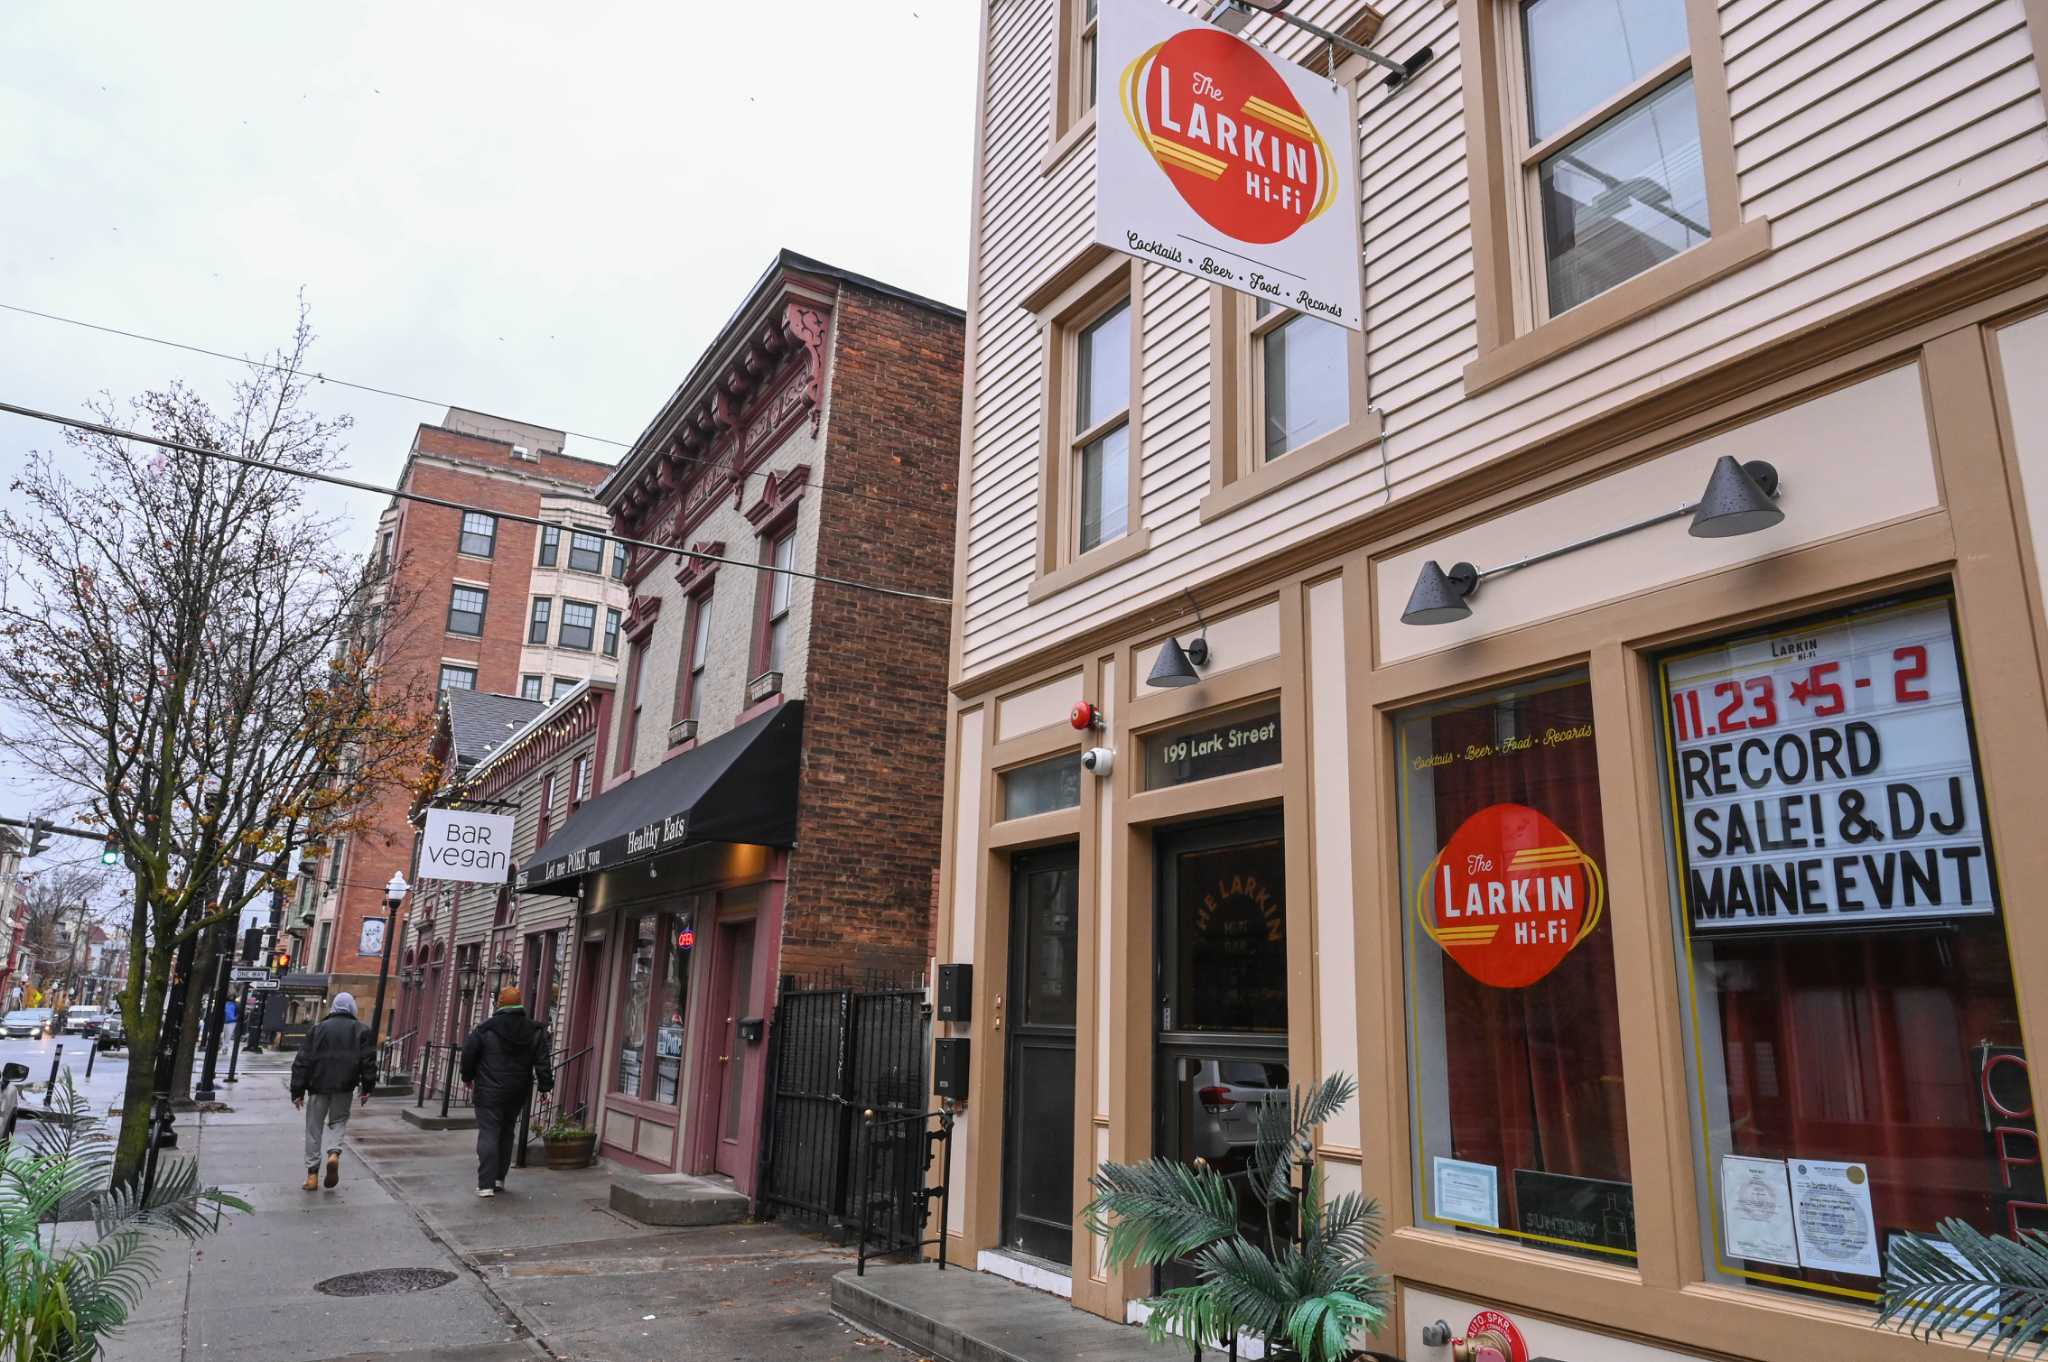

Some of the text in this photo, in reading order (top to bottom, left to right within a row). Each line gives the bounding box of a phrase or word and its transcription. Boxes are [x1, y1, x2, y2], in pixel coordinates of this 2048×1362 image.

[1192, 71, 1224, 102] The
[1160, 65, 1308, 184] LARKIN
[1246, 171, 1301, 214] Hi-Fi
[1127, 230, 1343, 318] Cocktails Beer Food Records
[1771, 639, 1817, 657] LARKIN
[1164, 721, 1276, 764] 199 Lark Street
[1413, 724, 1593, 770] Cocktails Beer Food Records
[1681, 720, 1881, 800] RECORD
[627, 816, 685, 854] Healthy Eats
[1693, 793, 1826, 858] SALE!
[428, 846, 506, 870] vegan
[545, 862, 555, 880] Let
[556, 862, 566, 876] me
[567, 848, 587, 873] POKE
[587, 850, 600, 871] you
[1467, 854, 1493, 875] The
[1443, 864, 1575, 918] LARKIN
[1514, 919, 1567, 945] Hi-Fi
[1487, 1312, 1510, 1329] SPKR
